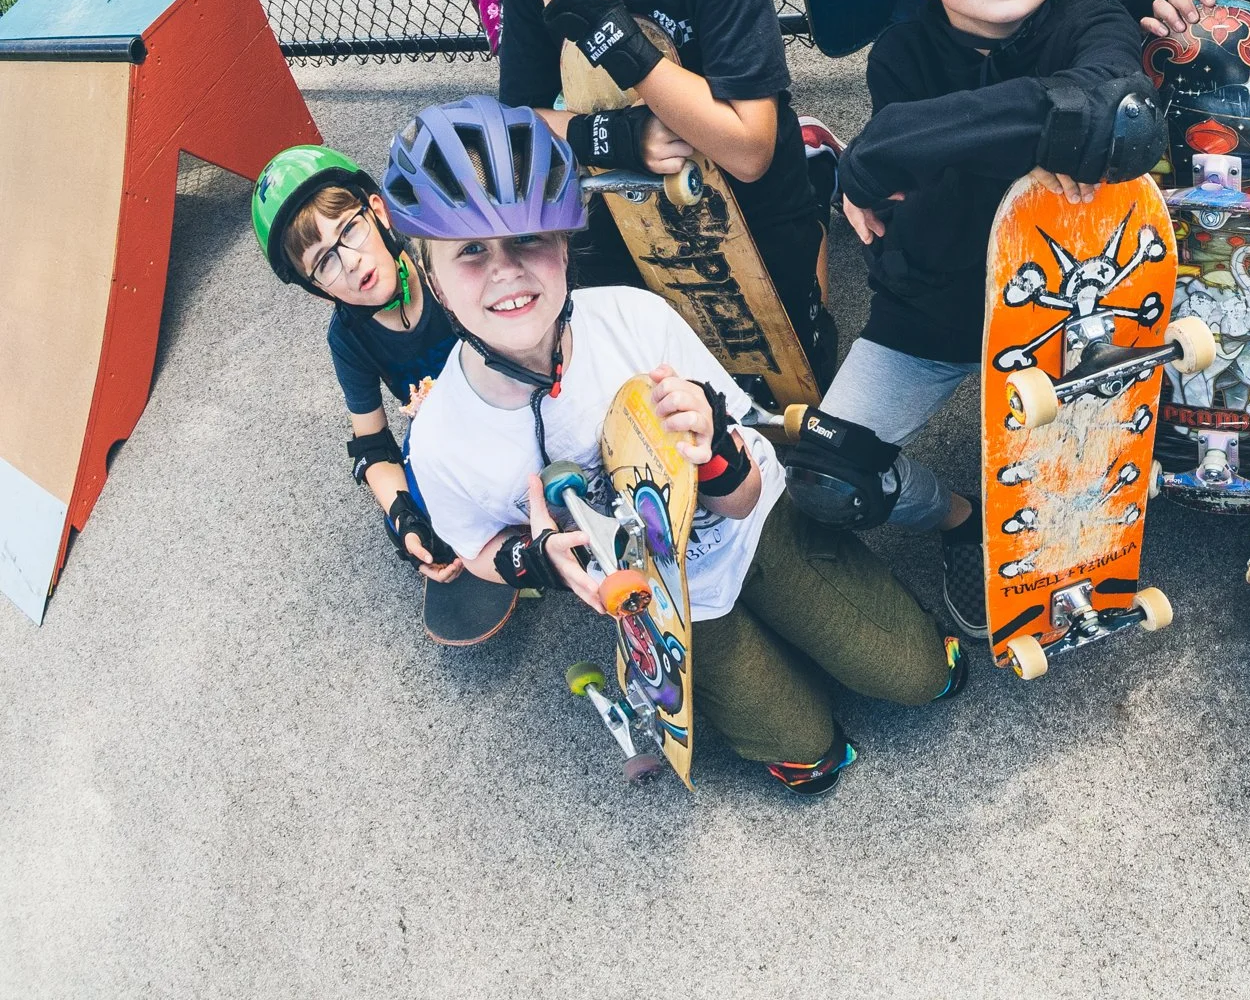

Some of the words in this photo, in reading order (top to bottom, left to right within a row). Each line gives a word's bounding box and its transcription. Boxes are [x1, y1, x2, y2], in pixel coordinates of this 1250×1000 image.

[587, 21, 615, 53] 187
[590, 43, 609, 61] KILLER
[608, 29, 625, 47] PADS
[599, 115, 609, 154] 187
